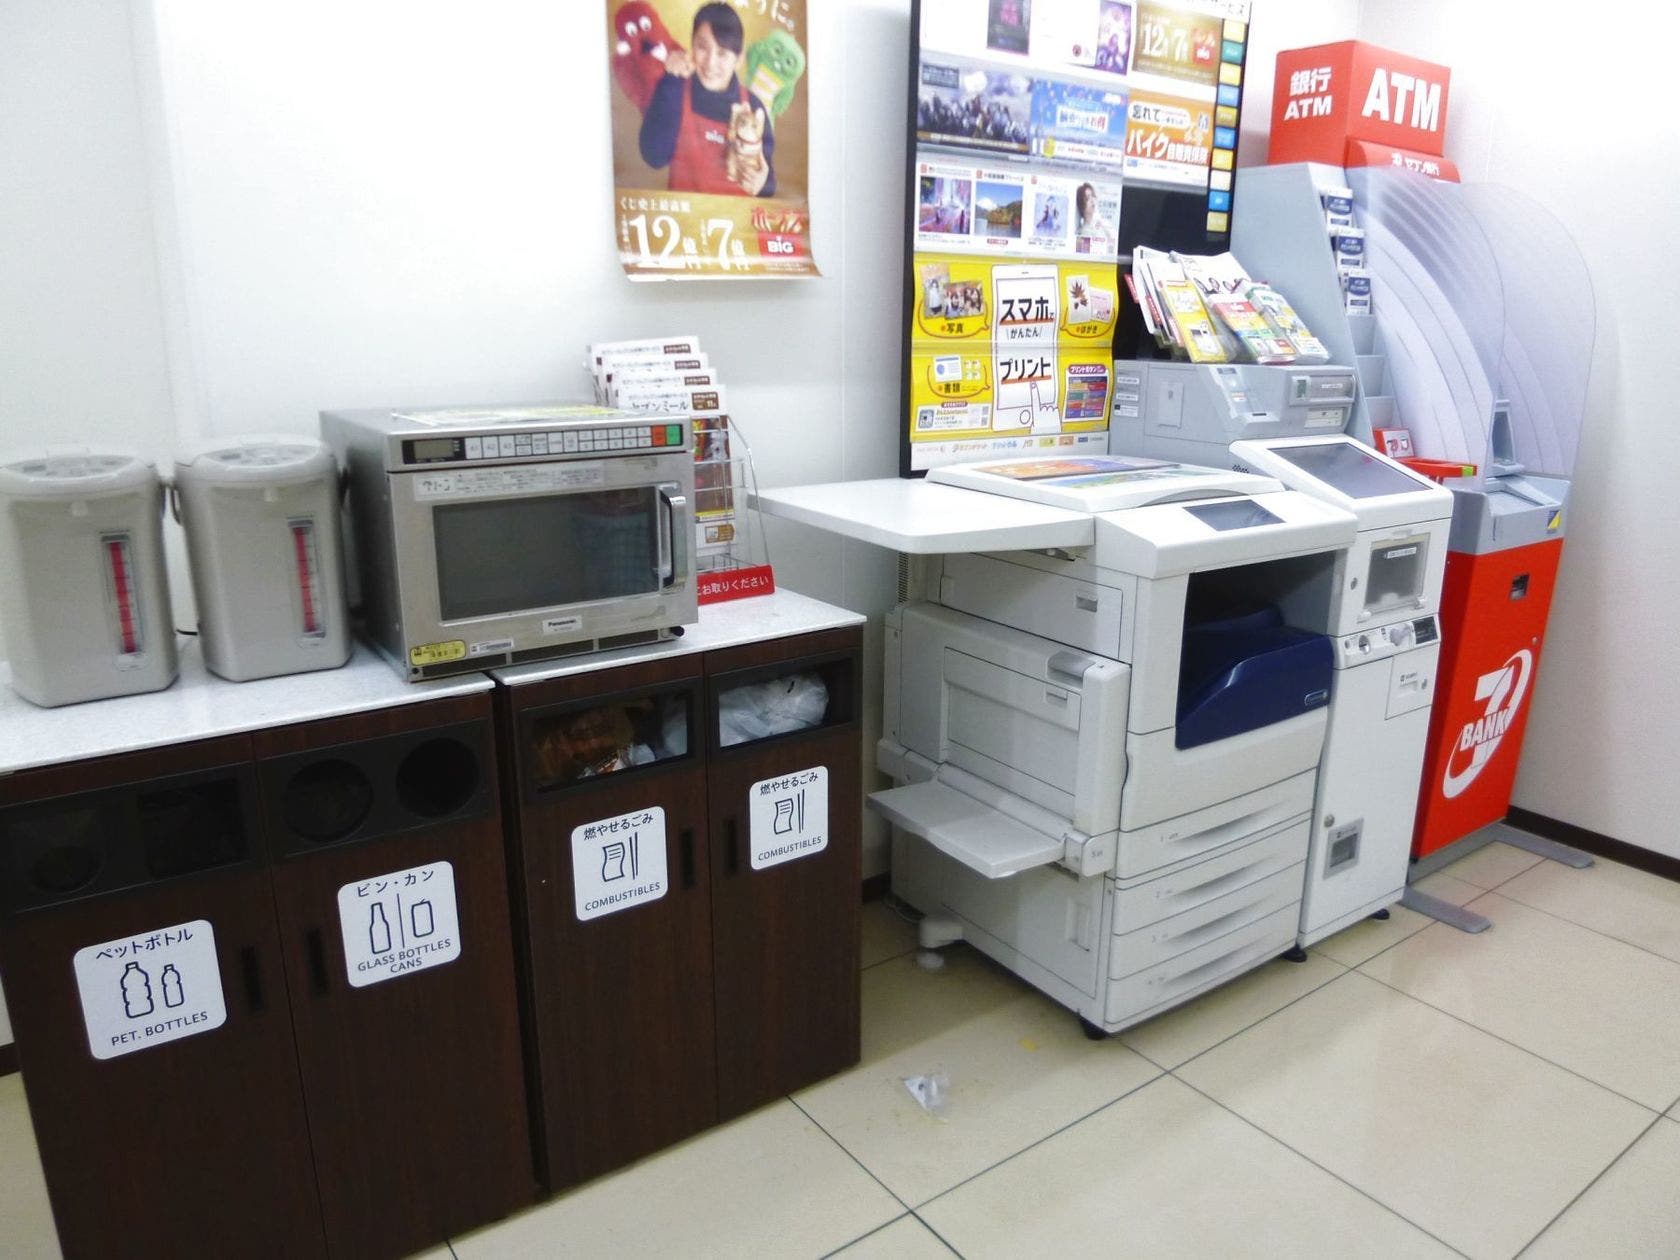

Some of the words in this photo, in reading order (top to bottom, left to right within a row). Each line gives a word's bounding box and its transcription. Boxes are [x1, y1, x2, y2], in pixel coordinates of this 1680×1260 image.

[1289, 66, 1332, 97] 銀行
[1283, 95, 1333, 121] ATM
[1361, 67, 1442, 132] ATM
[767, 236, 794, 254] BIG
[946, 322, 964, 334] 写真
[1010, 328, 1040, 340] かんたん
[1000, 357, 1051, 382] プリント
[1459, 707, 1510, 753] BANK
[759, 771, 819, 796] 燃やせるごみ
[583, 812, 654, 841] 燃やせるごみ
[757, 835, 823, 861] COMBUSTIBLES
[356, 868, 435, 898] ビン・カン
[584, 881, 661, 912] COMBUSTIBLES
[95, 928, 194, 960] ペットボトル
[357, 953, 396, 973] GLASS
[398, 938, 452, 962] BOTTLES
[389, 956, 423, 974] CANS
[110, 1028, 142, 1047] PET.
[145, 1010, 209, 1038] BOTTLES
